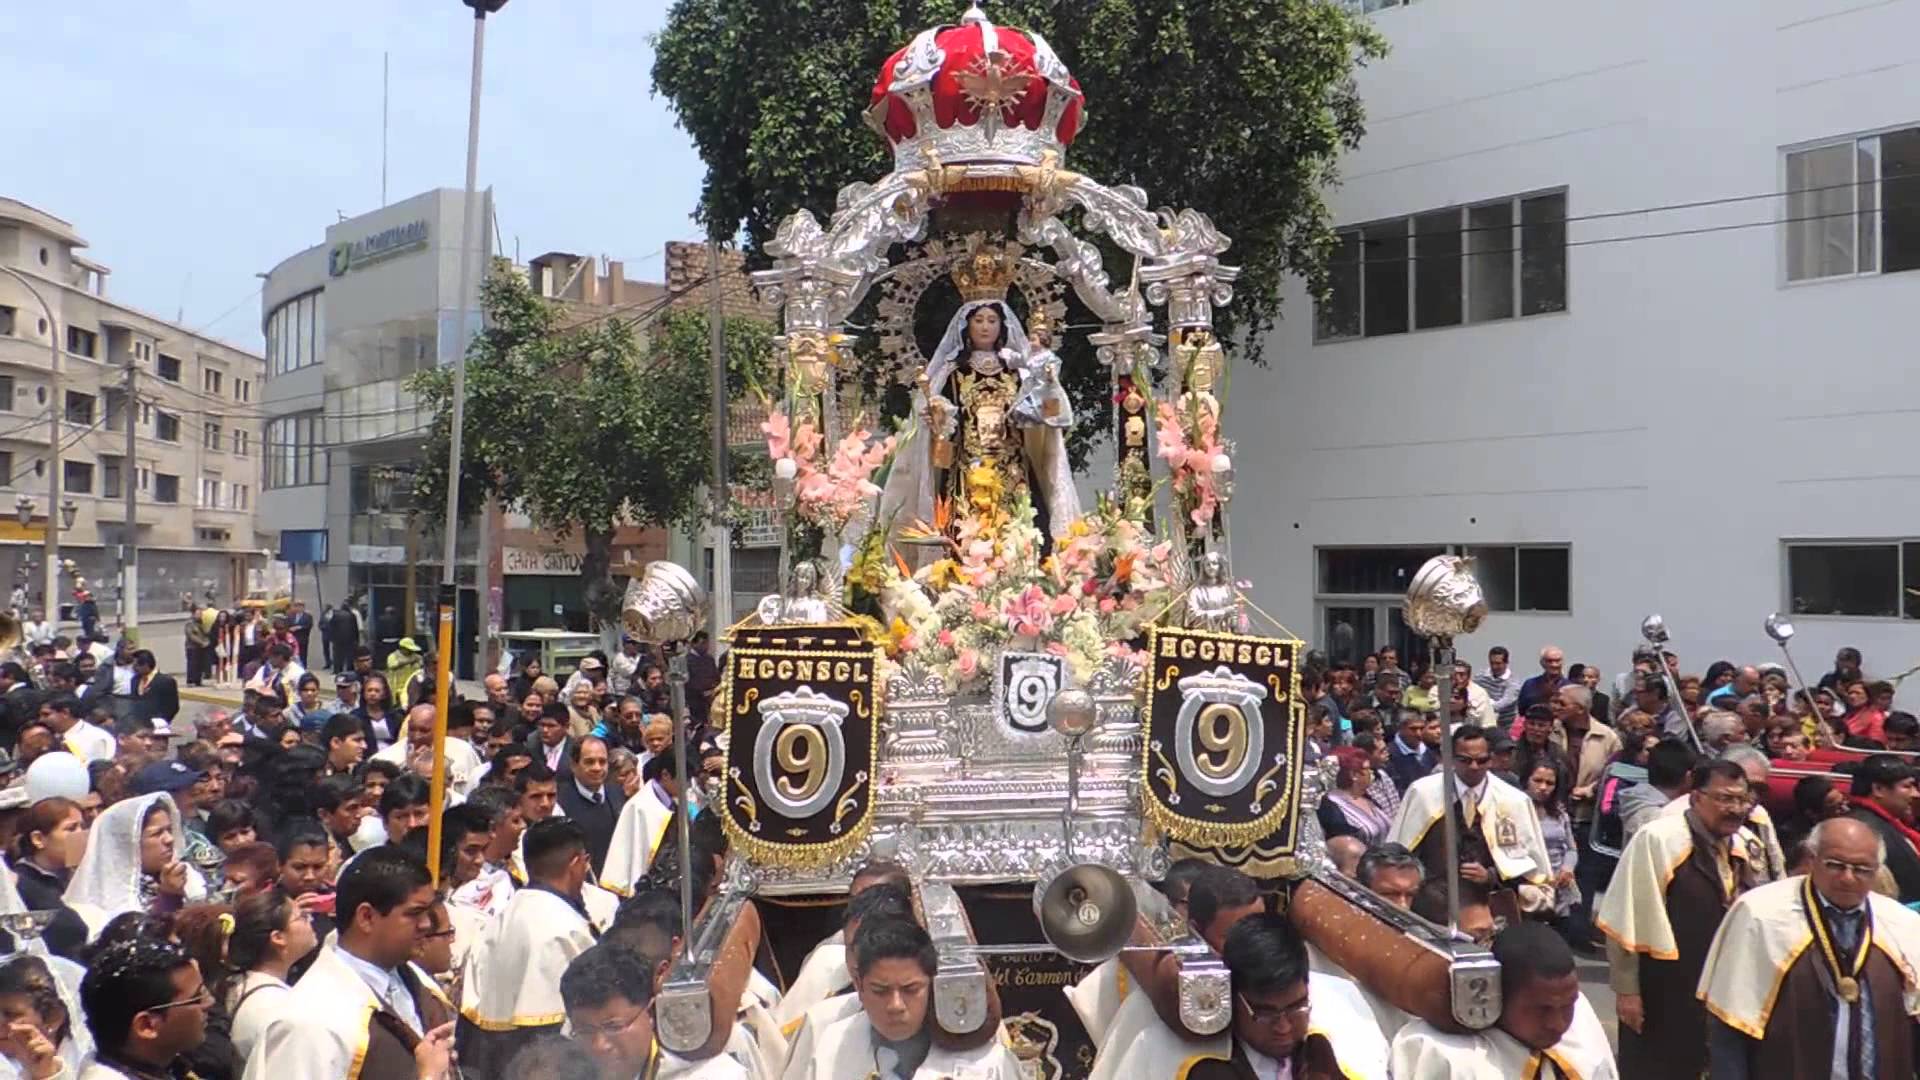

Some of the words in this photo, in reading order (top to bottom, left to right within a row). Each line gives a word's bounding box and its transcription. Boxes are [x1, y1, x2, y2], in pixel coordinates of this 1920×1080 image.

[1160, 636, 1289, 668] HCCNSCL
[738, 658, 868, 682] HCCNSCL
[1018, 676, 1047, 718] 9
[1197, 703, 1248, 778] 9
[776, 723, 827, 800] 9
[953, 996, 967, 1017] 3
[1469, 977, 1489, 1005] 2
